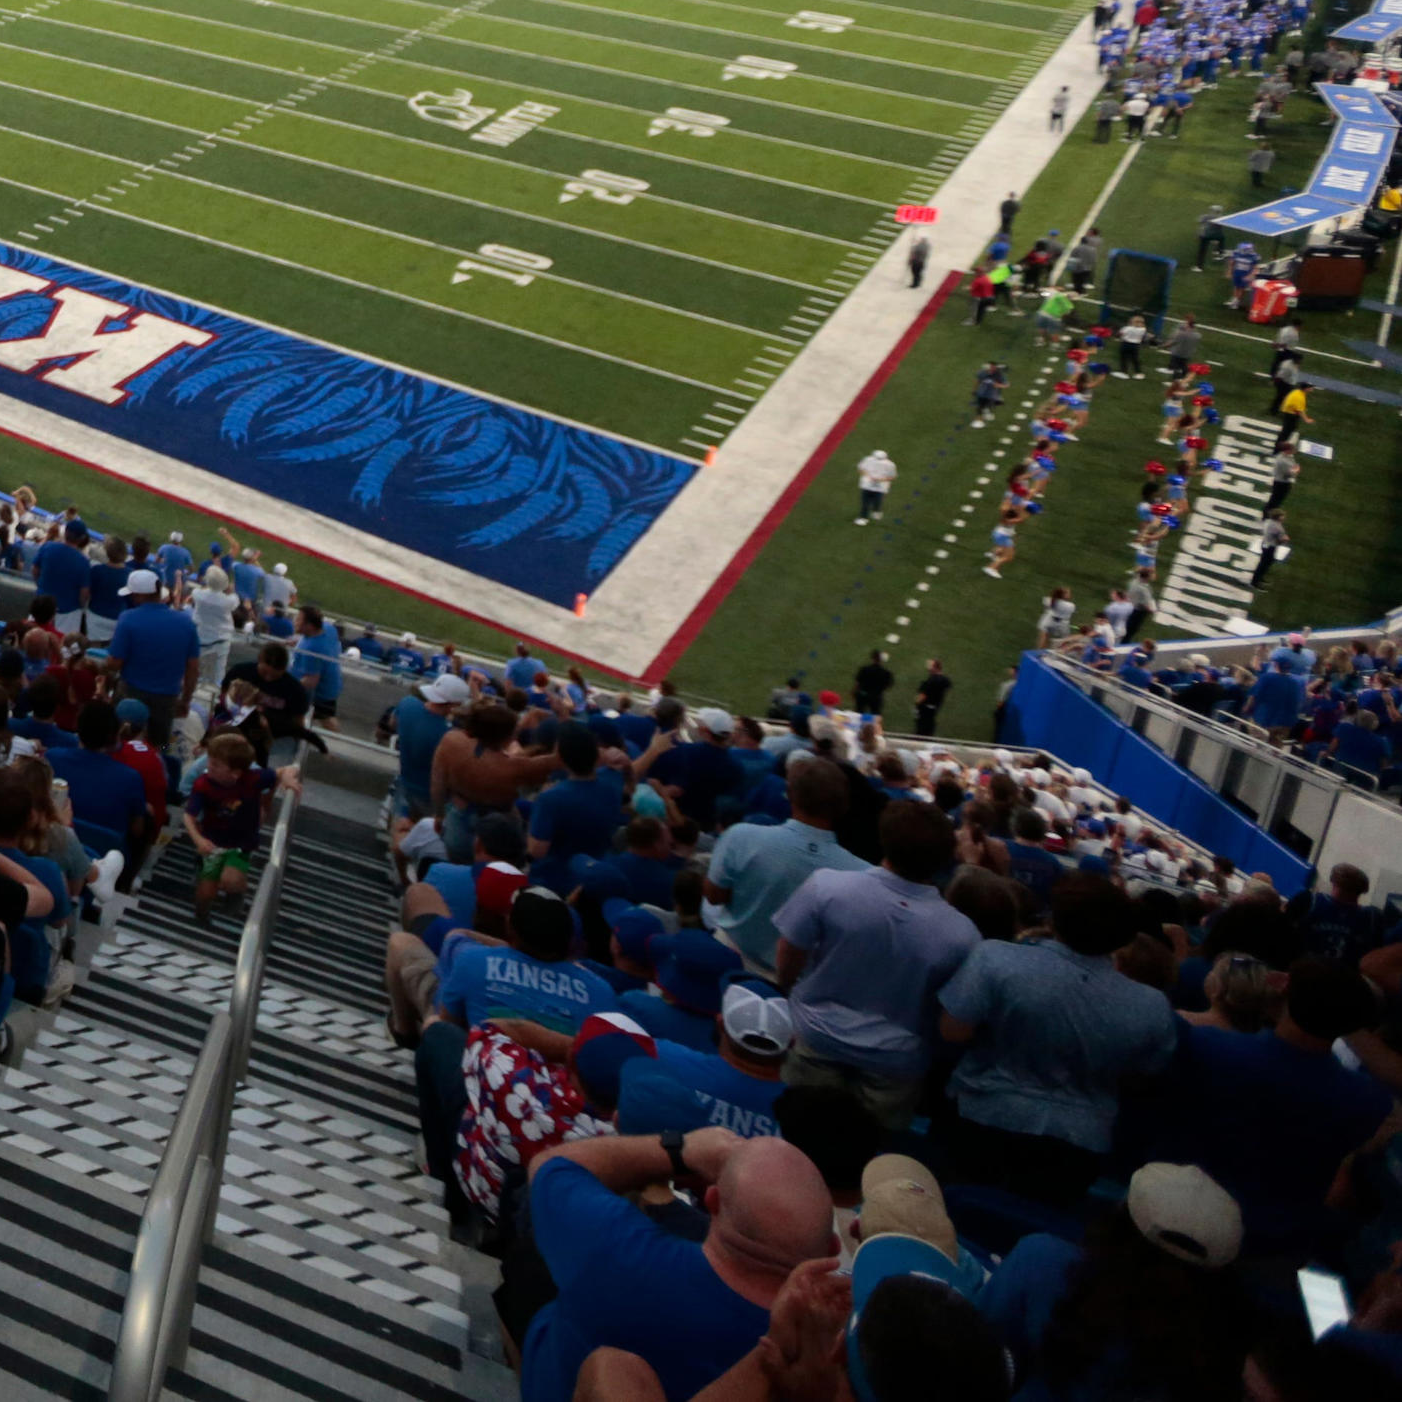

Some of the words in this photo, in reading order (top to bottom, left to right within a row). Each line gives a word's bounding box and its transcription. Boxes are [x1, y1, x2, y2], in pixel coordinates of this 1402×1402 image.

[652, 107, 731, 137] 30
[565, 170, 650, 204] 20
[458, 244, 553, 286] 10
[1153, 496, 1265, 640] KIVISTO
[485, 955, 590, 1005] KANSAS
[695, 1089, 783, 1139] ANS
